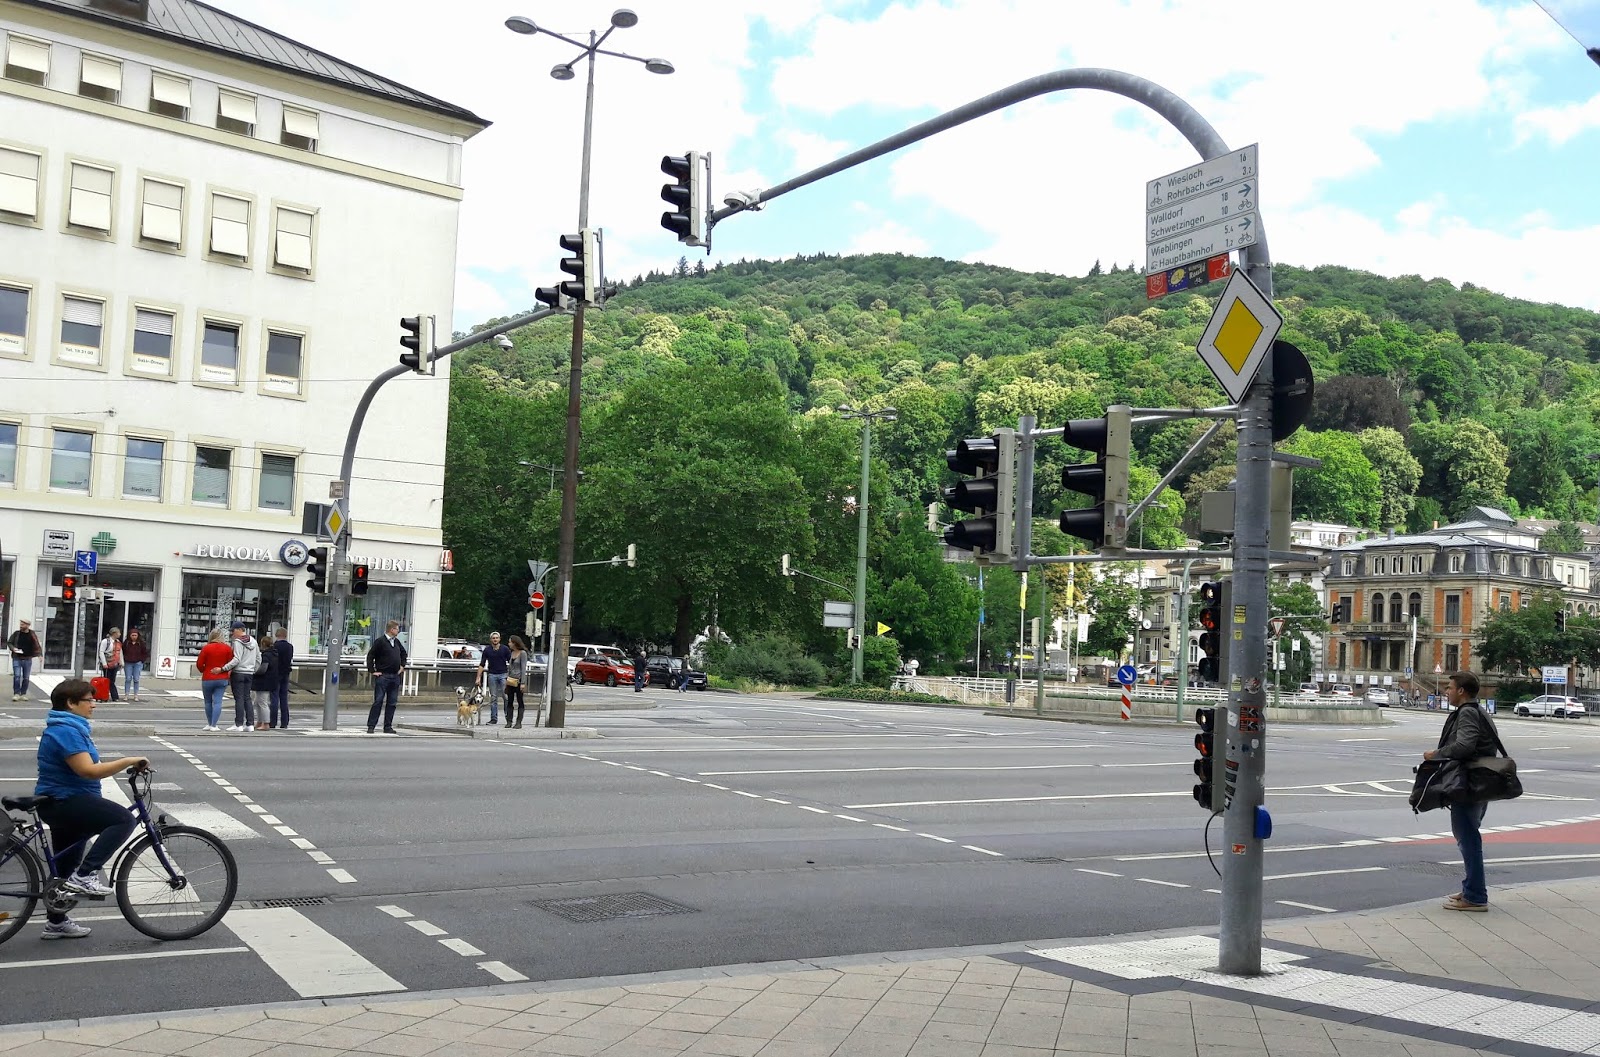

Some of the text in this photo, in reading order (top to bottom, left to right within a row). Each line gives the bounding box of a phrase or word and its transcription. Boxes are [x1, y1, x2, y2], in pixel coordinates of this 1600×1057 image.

[1167, 153, 1247, 188] Wiesloch 16
[1167, 181, 1205, 202] Rohrbach
[1150, 192, 1229, 226] Walldorf 18
[1150, 205, 1229, 239] Schwetzingen 10
[1151, 236, 1193, 257] Wieblingen
[1159, 243, 1214, 268] Hauptbahnhof
[195, 543, 274, 562] EUROPA
